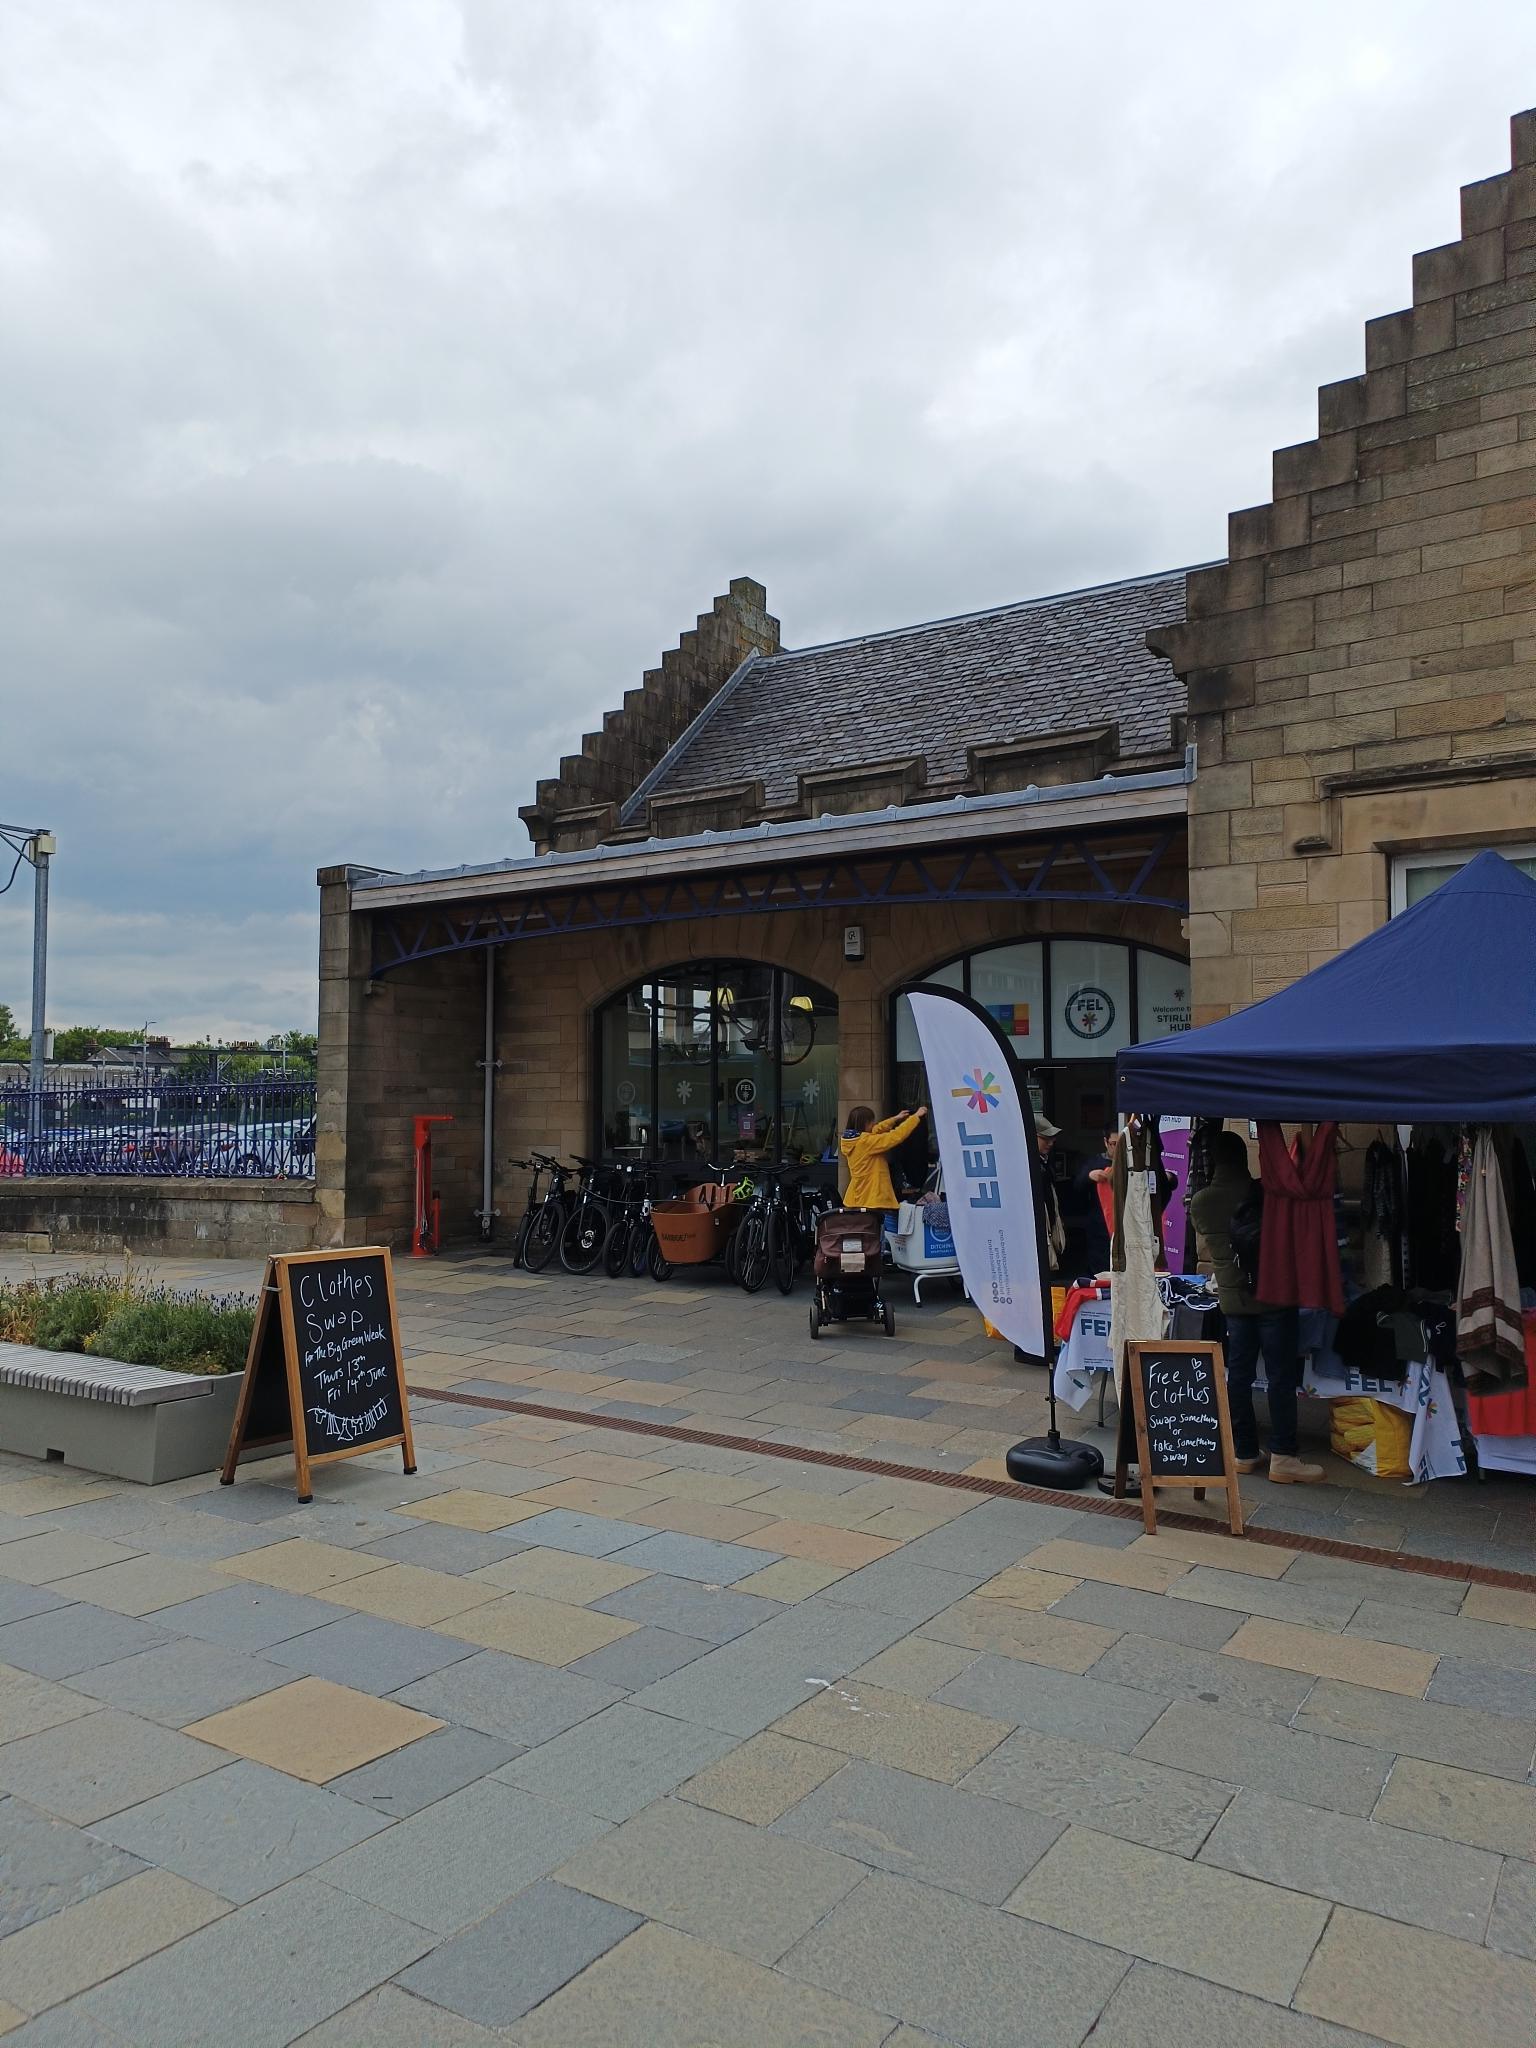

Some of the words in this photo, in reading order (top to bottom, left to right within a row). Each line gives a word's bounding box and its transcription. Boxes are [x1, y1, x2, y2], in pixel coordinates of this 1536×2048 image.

[1078, 999, 1104, 1011] FEL
[1157, 1014, 1192, 1023] STIRLI
[300, 1268, 373, 1307] Clothes
[306, 1309, 363, 1344] Swap
[327, 1341, 343, 1362] Big
[341, 1336, 365, 1351] Green
[313, 1367, 344, 1390] Thurs
[327, 1384, 341, 1405] Fri
[365, 1366, 388, 1388] June
[1148, 1361, 1181, 1389] Free
[1345, 1374, 1393, 1393] FEL
[1152, 1440, 1175, 1452] take
[1162, 1453, 1188, 1466] away
